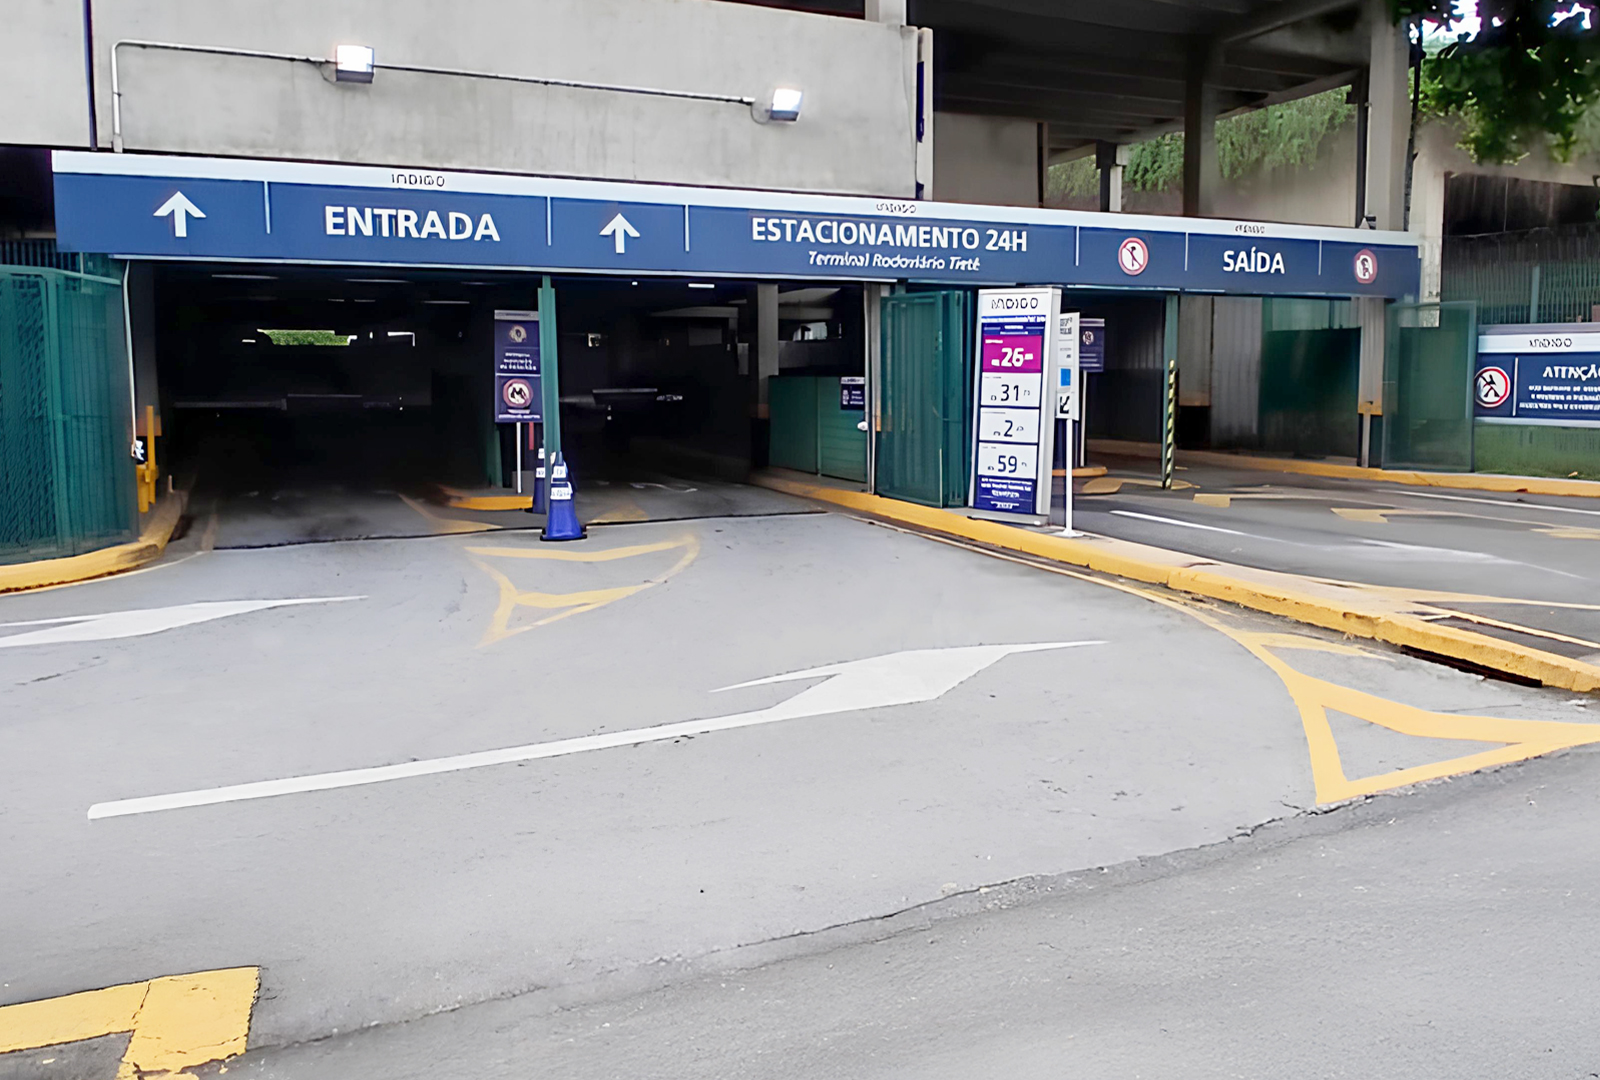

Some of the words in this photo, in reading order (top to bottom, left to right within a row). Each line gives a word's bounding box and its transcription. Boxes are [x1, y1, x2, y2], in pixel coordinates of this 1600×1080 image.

[325, 205, 501, 242] ENTRADA
[752, 217, 980, 250] ESTACIONAMENTO
[985, 229, 1027, 252] 24H
[809, 251, 869, 267] Terminal
[1223, 246, 1285, 274] SAÍDA
[1001, 348, 1024, 367] 26
[1001, 384, 1020, 401] 31
[998, 455, 1018, 473] 59
